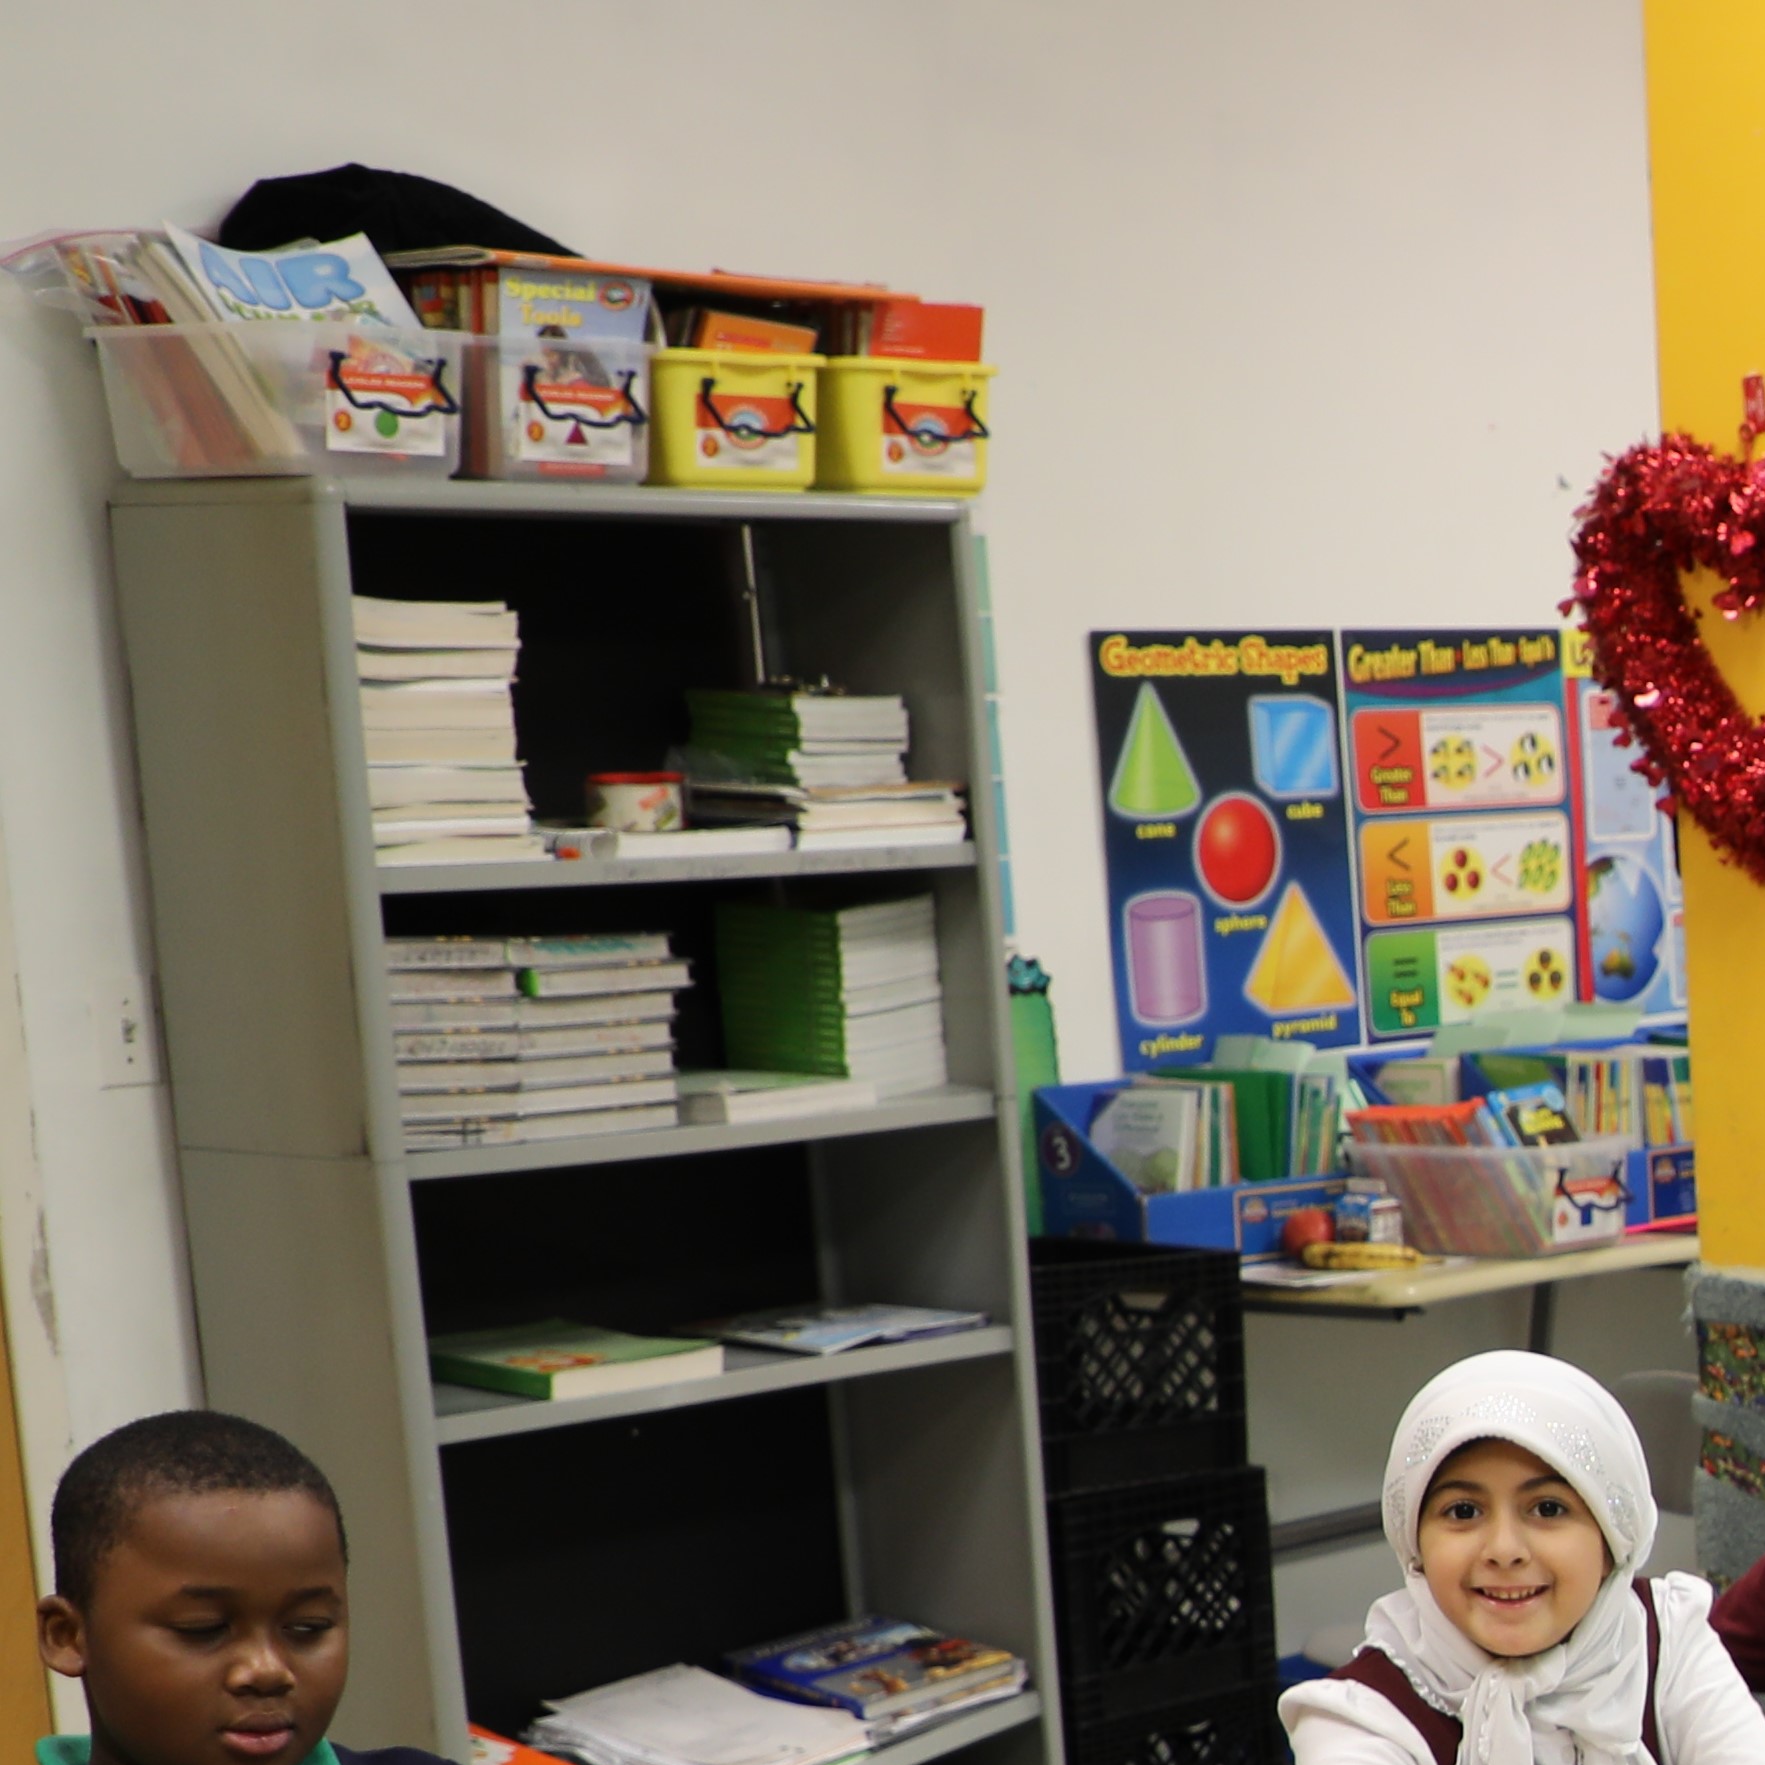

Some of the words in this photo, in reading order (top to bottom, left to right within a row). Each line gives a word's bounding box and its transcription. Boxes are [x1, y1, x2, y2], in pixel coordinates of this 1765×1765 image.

[198, 241, 365, 310] AIR
[506, 276, 596, 302] Special
[520, 302, 582, 327] Tools
[1101, 634, 1239, 677] Geometric
[1239, 635, 1328, 685] Shapes
[1348, 644, 1417, 683] Greater
[1418, 640, 1456, 675] Than
[1463, 639, 1488, 670] Less
[1487, 637, 1516, 667] Than
[1370, 765, 1413, 786] Greater
[1379, 786, 1409, 805] Than
[1286, 802, 1324, 820] cube
[1136, 823, 1176, 839] cone
[1386, 879, 1413, 896] Less
[1387, 900, 1416, 918] Than
[1214, 913, 1268, 937] sphere
[1390, 988, 1423, 1008] Equal
[1272, 1014, 1338, 1039] pyramid
[1401, 1007, 1416, 1026] To
[1140, 1033, 1204, 1058] cylinder
[1052, 1136, 1071, 1171] 3
